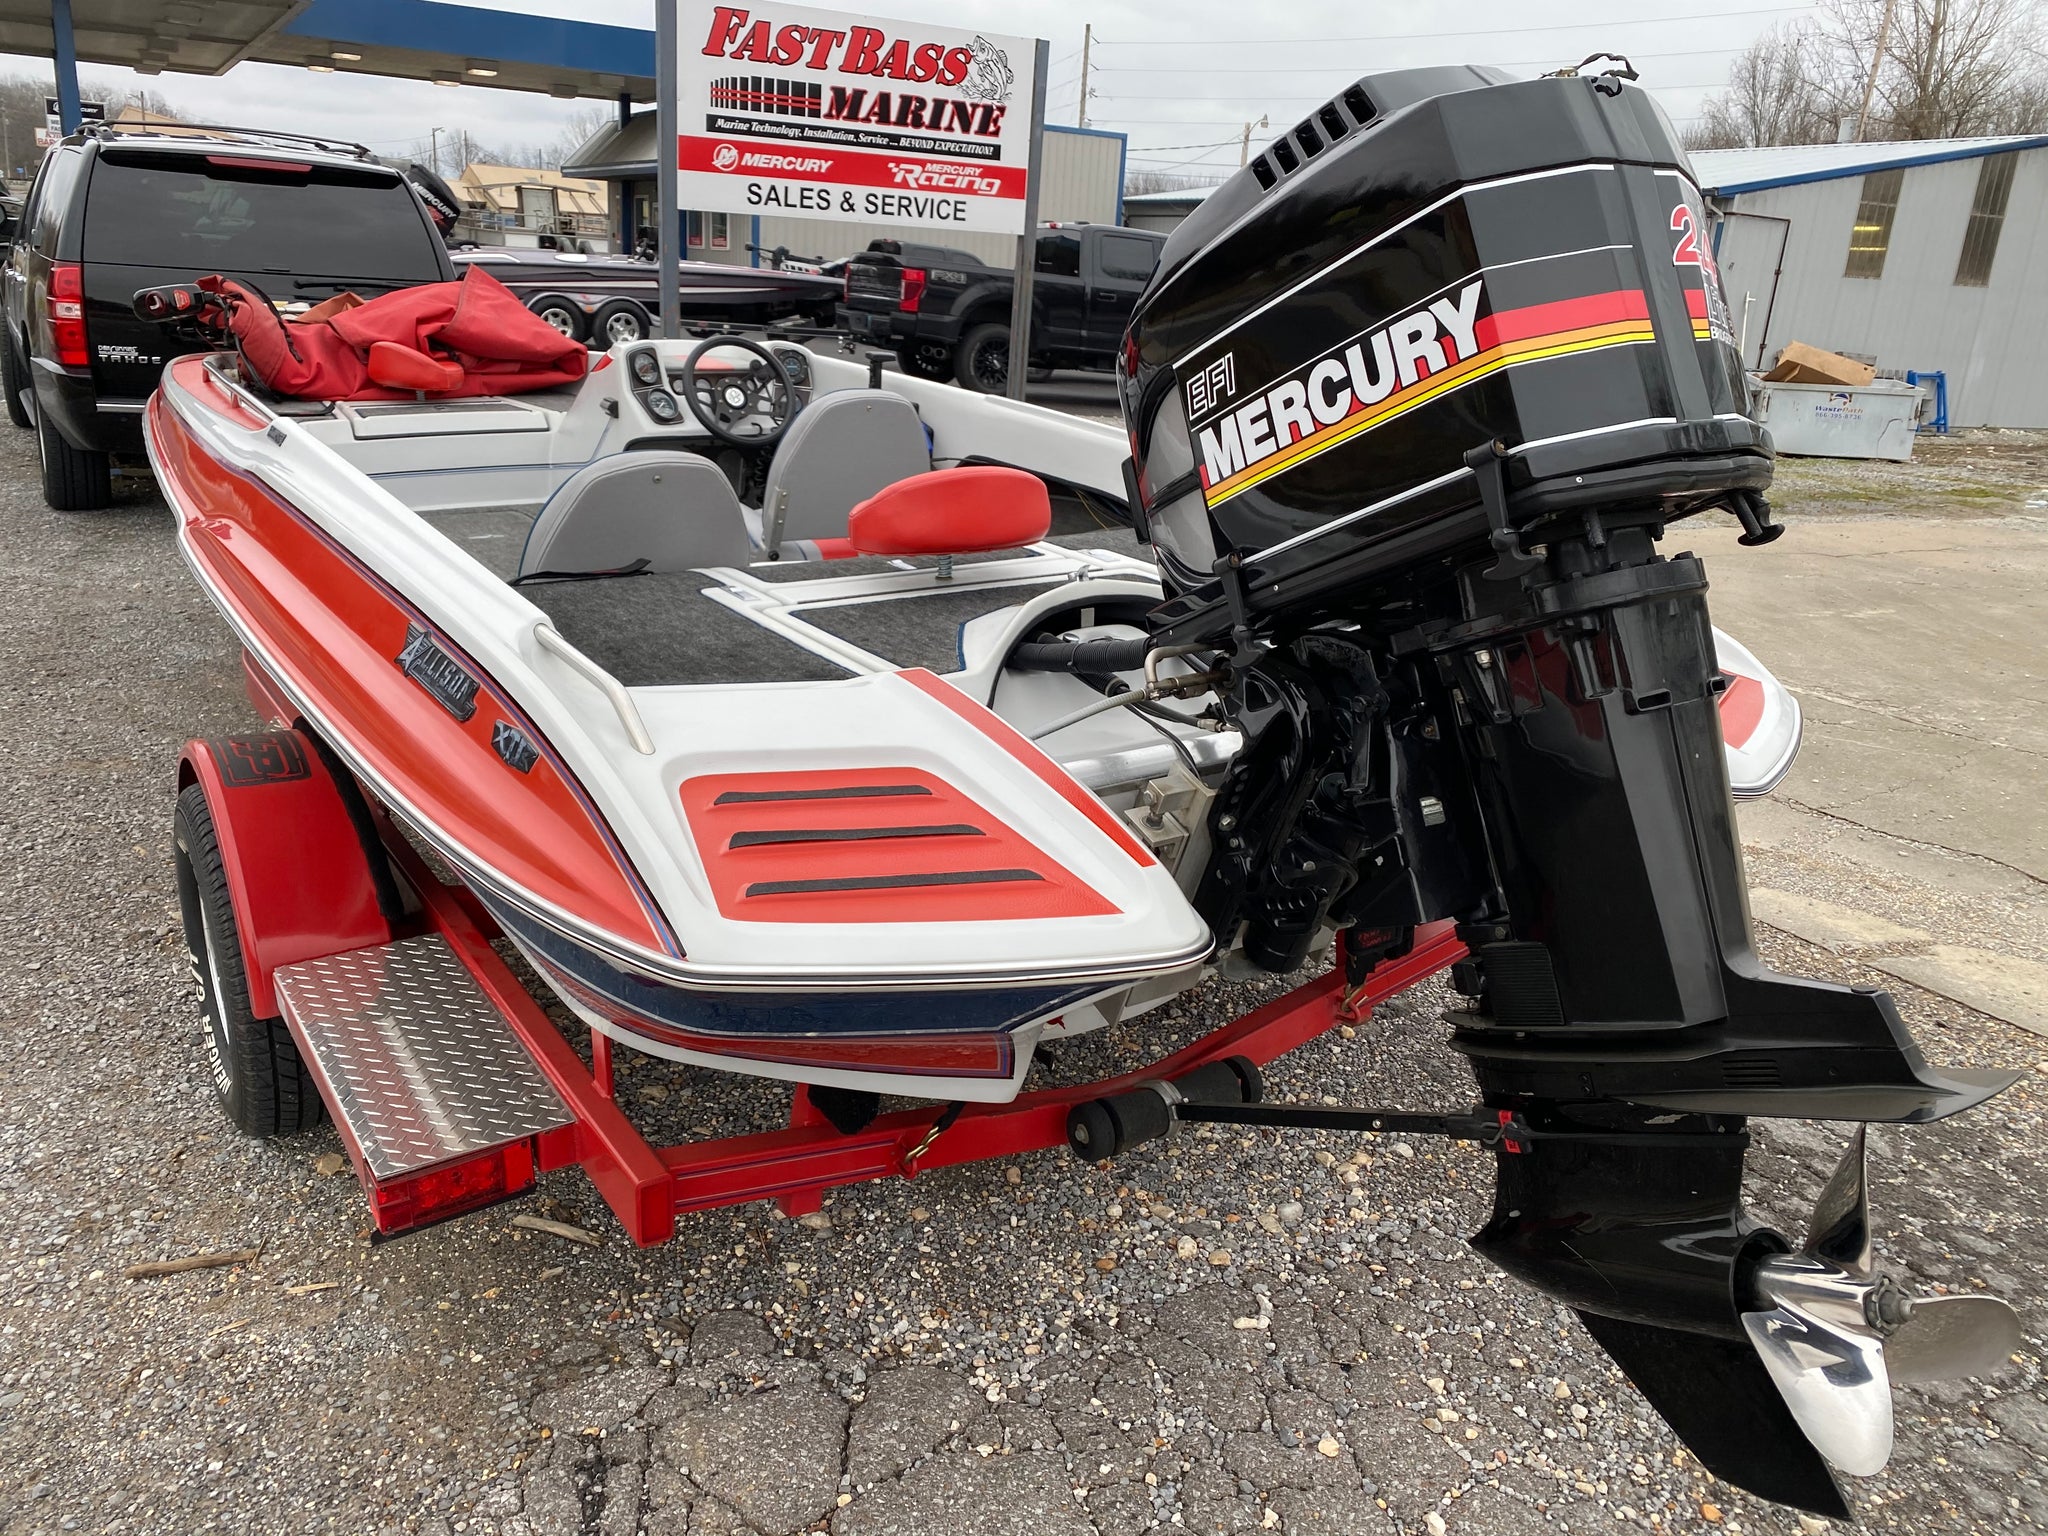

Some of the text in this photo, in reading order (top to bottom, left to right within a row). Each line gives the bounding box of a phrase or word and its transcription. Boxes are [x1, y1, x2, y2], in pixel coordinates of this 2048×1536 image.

[823, 85, 1006, 137] MARINE
[715, 118, 749, 131] Marine
[858, 132, 889, 146] Service
[900, 137, 934, 150] BEYOND
[741, 153, 833, 173] MERCURY
[925, 162, 983, 176] MERCURY
[410, 181, 457, 218] MERCURY
[747, 183, 967, 221] SALES & SERVICE
[98, 354, 162, 365] TAHOE
[1186, 351, 1236, 421] EFI
[1199, 279, 1483, 486] MERCURY
